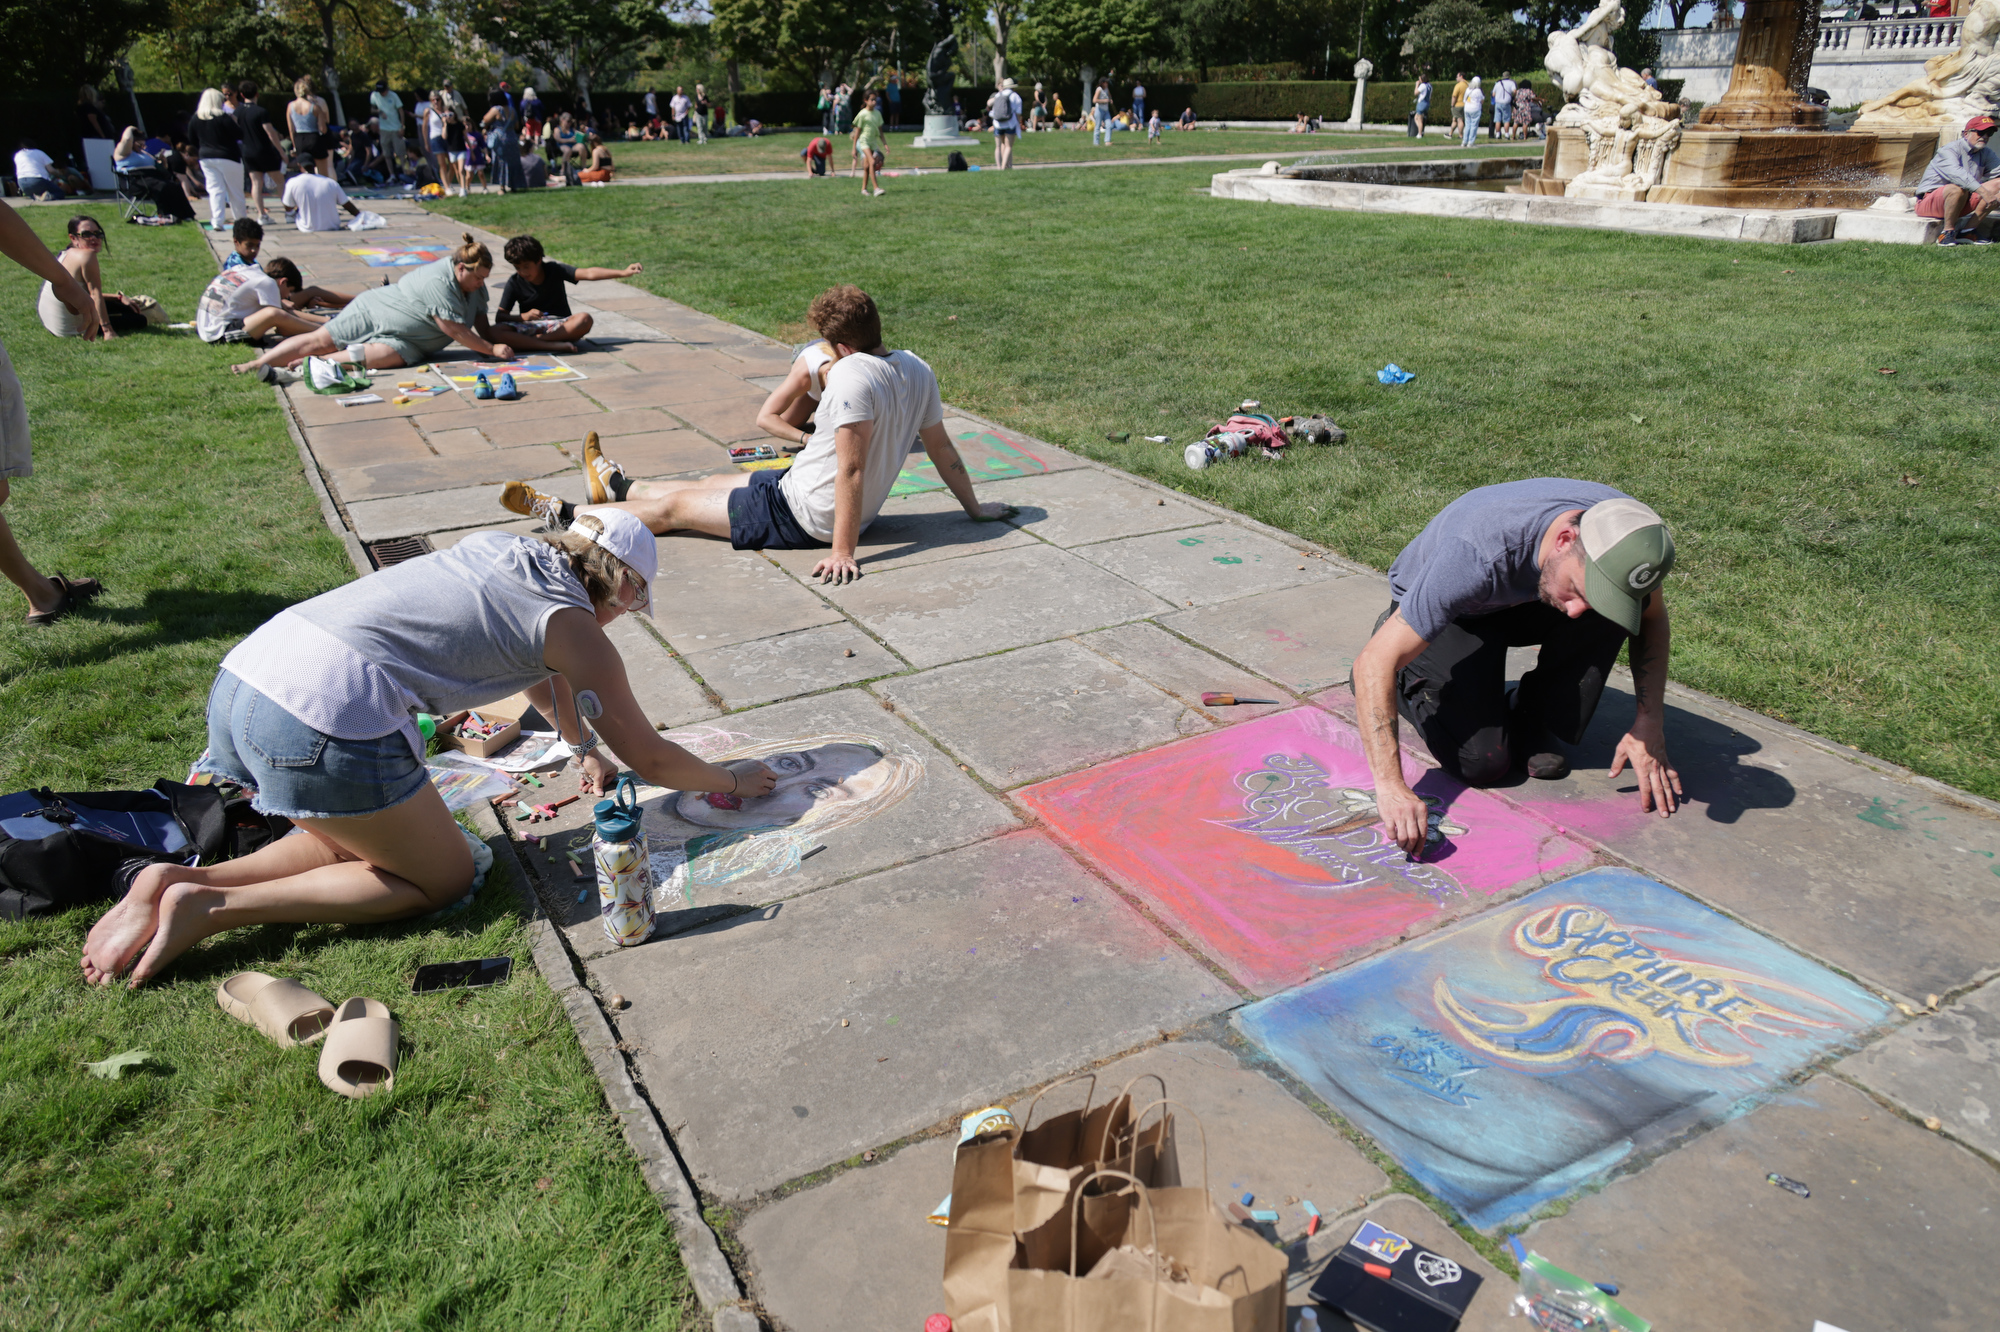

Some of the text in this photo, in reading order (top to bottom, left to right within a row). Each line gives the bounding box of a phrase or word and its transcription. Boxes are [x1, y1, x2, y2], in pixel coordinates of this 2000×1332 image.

[1522, 908, 1758, 1023] SAPPHIRE
[1549, 955, 1714, 1052] CREEK
[1411, 1027, 1489, 1069] WINERY
[1354, 1222, 1411, 1259] MTV
